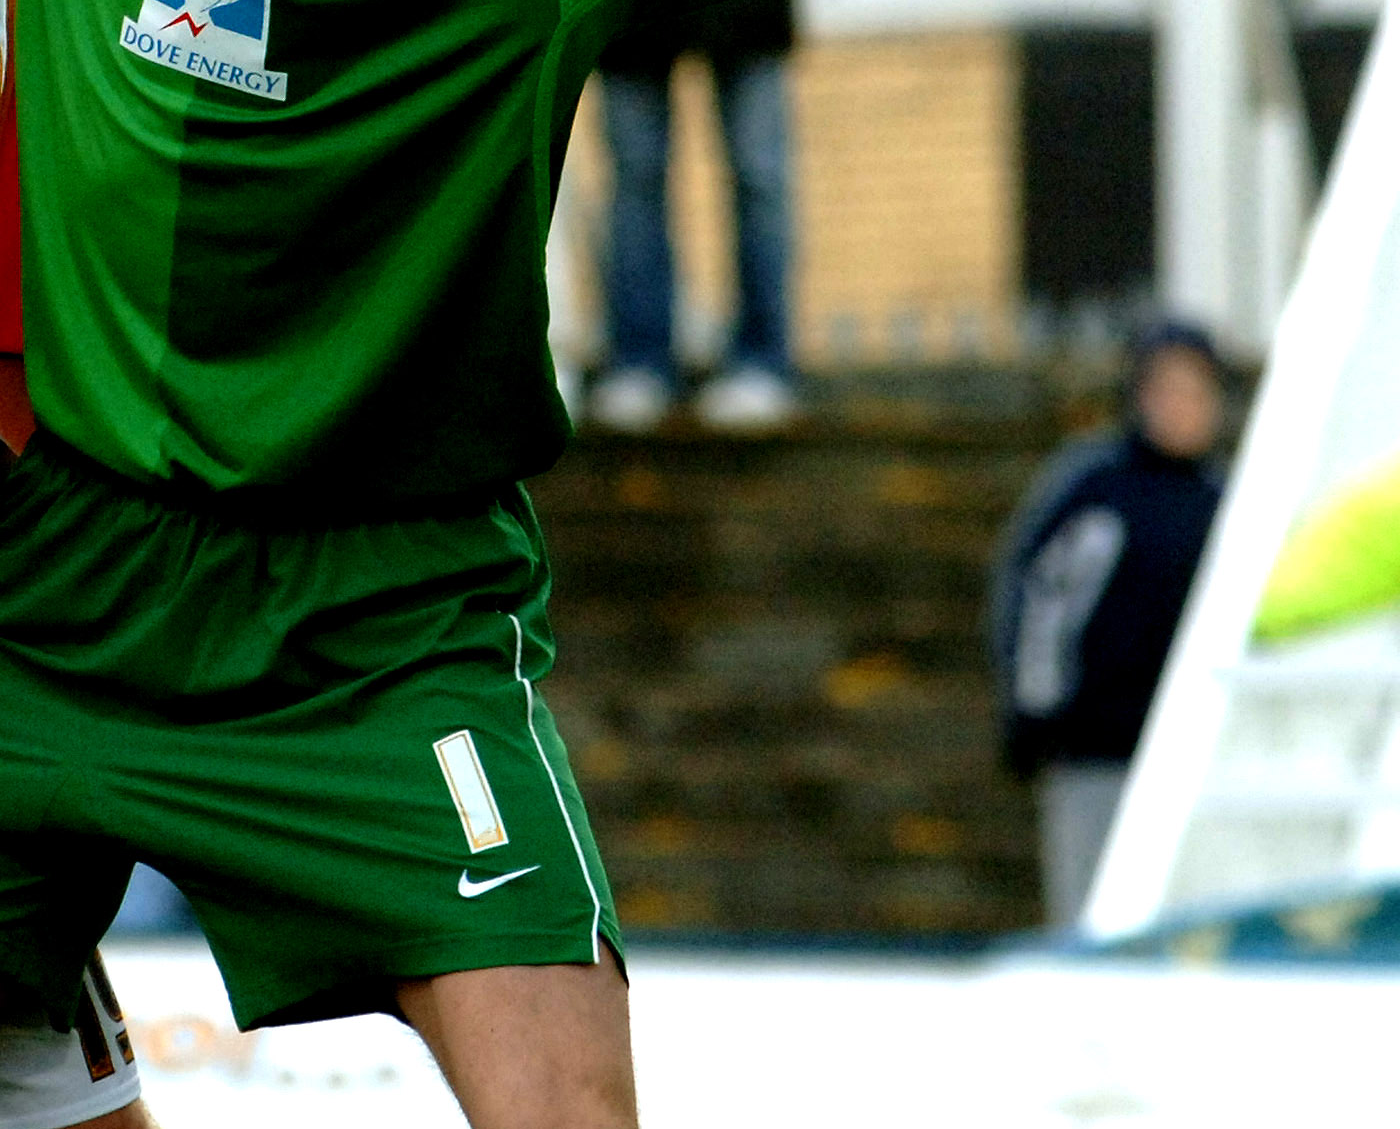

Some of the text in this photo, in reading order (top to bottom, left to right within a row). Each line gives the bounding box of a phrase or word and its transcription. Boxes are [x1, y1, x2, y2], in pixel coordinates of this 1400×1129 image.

[124, 25, 280, 93] DOVE ENERGY
[433, 729, 509, 855] 1
